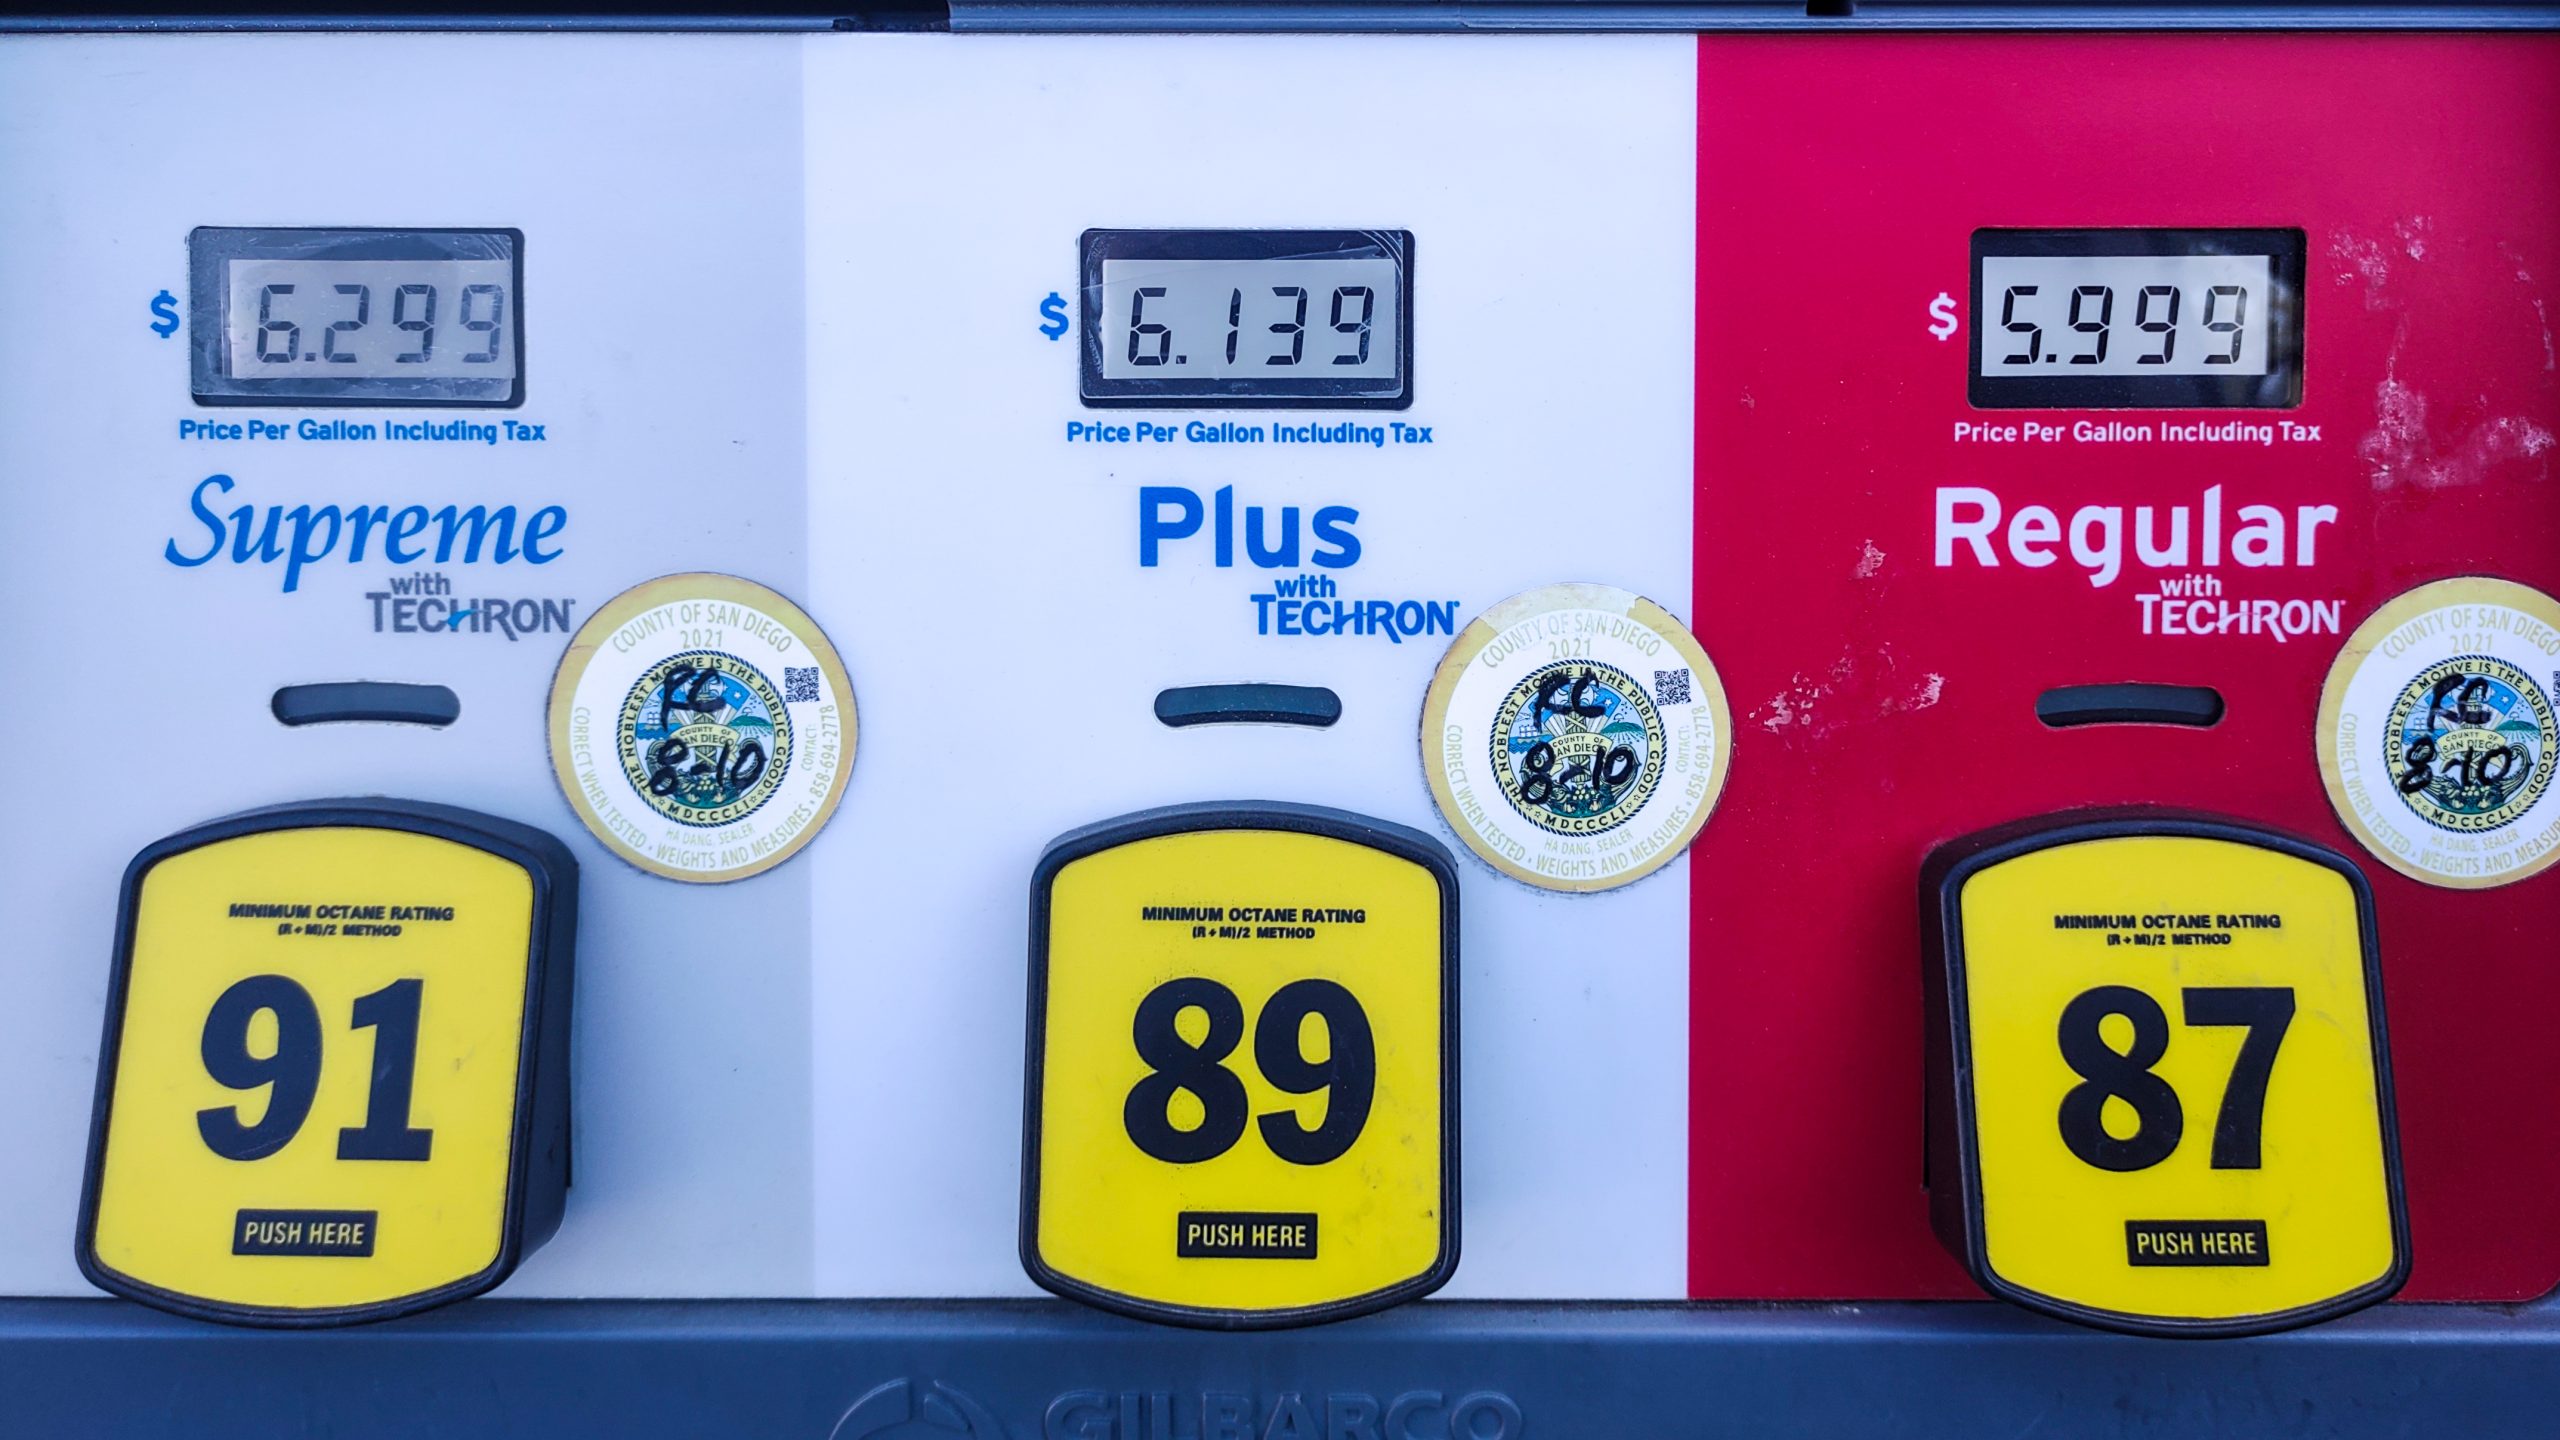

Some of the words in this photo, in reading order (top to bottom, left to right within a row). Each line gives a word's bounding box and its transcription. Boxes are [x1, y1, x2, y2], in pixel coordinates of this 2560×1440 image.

[149, 290, 180, 339] $
[256, 284, 503, 364] 6.299
[1038, 291, 1070, 341] $
[1127, 286, 1375, 366] 6.139
[1927, 291, 1959, 341] $
[2000, 285, 2248, 365] 5.999
[180, 419, 242, 441] Price
[249, 419, 290, 441] Per
[297, 419, 376, 441] Gallon
[386, 419, 497, 445] Including
[502, 420, 546, 441] Tax
[1067, 421, 1130, 443] Price
[1137, 421, 1178, 443] Per
[1186, 421, 1264, 443] Gallon
[1273, 421, 1384, 448] Including
[1390, 422, 1434, 443] Tax
[1954, 420, 2017, 442] Price
[2024, 421, 2065, 442] Per
[2073, 420, 2152, 442] Gallon
[2161, 420, 2273, 446] Including
[2278, 420, 2321, 442] Tax
[164, 474, 567, 593] Supreme
[1140, 484, 1361, 569] Plus
[1934, 484, 2338, 587] Regular
[389, 572, 451, 596] with
[1274, 574, 1337, 598] with
[2159, 574, 2222, 597] with
[365, 592, 575, 642] TECHRON
[612, 608, 676, 654] COUNTY
[680, 602, 701, 624] OF
[707, 603, 741, 627] SAN
[743, 611, 793, 654] DIEGO
[680, 628, 724, 649] 2021
[1250, 593, 1460, 643] TECHRON
[2134, 593, 2346, 643] TECHRON
[2382, 611, 2446, 660] COUNTY
[2451, 608, 2471, 630] OF
[2477, 608, 2511, 633] SAN
[2513, 616, 2560, 657] DIEGO
[1481, 618, 1543, 669] COUNTY
[1548, 613, 1569, 635] OF
[1574, 612, 1607, 638] SAN
[1611, 618, 1662, 658] DIEGO
[1548, 638, 1591, 660] 2021
[2450, 633, 2493, 654] 2021
[709, 657, 723, 669] IS
[728, 662, 757, 684] THE
[1598, 669, 1626, 690] THE
[2418, 662, 2473, 690] MOTIVE
[2478, 662, 2491, 673] IS
[2498, 666, 2524, 688] THE
[623, 685, 652, 758] NOBLEST
[679, 726, 714, 737] COUNTY
[757, 685, 788, 738] PUBLIC
[1628, 689, 1660, 742] PUBLIC
[2390, 691, 2417, 764] NOBLEST
[2525, 688, 2554, 742] PUBLIC
[572, 706, 594, 767] CORRECT
[809, 704, 839, 799] 858-694-2778
[1445, 724, 1468, 785] CORRECT
[1497, 701, 1520, 773] NOBLEST
[1552, 735, 1586, 748] COUNTY
[1593, 736, 1604, 744] OF
[1686, 705, 1712, 800] 858-694-2778
[2339, 712, 2360, 774] CORRECT
[2443, 740, 2464, 754] SAN
[2487, 733, 2499, 741] OF
[650, 738, 768, 796] 8-10
[762, 746, 787, 790] GOOD
[1521, 742, 1635, 804] 8-10
[1638, 749, 1660, 794] GOOD
[2528, 750, 2553, 794] GOOD
[580, 769, 609, 811] WHEN
[1456, 785, 1488, 827] WHEN
[2345, 774, 2373, 818] WHEN
[604, 806, 647, 849] TESTED
[656, 842, 716, 868] WEIGHTS
[720, 846, 749, 868] AND
[750, 803, 812, 858] MEASURES
[1482, 820, 1526, 862] TESTED
[1536, 852, 1596, 877] WEIGHTS
[1601, 852, 1629, 875] AND
[1630, 804, 1690, 863] MEASURES
[1597, 828, 1634, 853] SEALER
[2369, 811, 2412, 857] TESTED
[2421, 847, 2480, 874] WEIGHTS
[2484, 851, 2513, 873] AND
[228, 904, 312, 919] MINIMUM
[316, 905, 387, 920] OCTANE
[390, 906, 455, 921] RATING
[342, 925, 402, 937] METHOD
[1142, 906, 1224, 922] MINIMUM
[1229, 907, 1298, 923] OCTANE
[1302, 909, 1366, 924] RATING
[1257, 927, 1316, 939] METHOD
[2054, 914, 2137, 930] MINIMUM
[2142, 914, 2212, 929] OCTANE
[2216, 914, 2282, 929] RATING
[2172, 934, 2232, 946] METHOD
[196, 974, 434, 1162] 91
[1123, 977, 1376, 1166] 89
[2057, 985, 2296, 1172] 87
[244, 1221, 302, 1244] PUSH
[309, 1222, 365, 1245] HERE
[1188, 1224, 1244, 1247] PUSH
[1252, 1225, 1306, 1247] HERE
[2136, 1232, 2194, 1255] PUSH
[2201, 1232, 2257, 1255] HERE
[1044, 1390, 1523, 1440] GILBARCO
